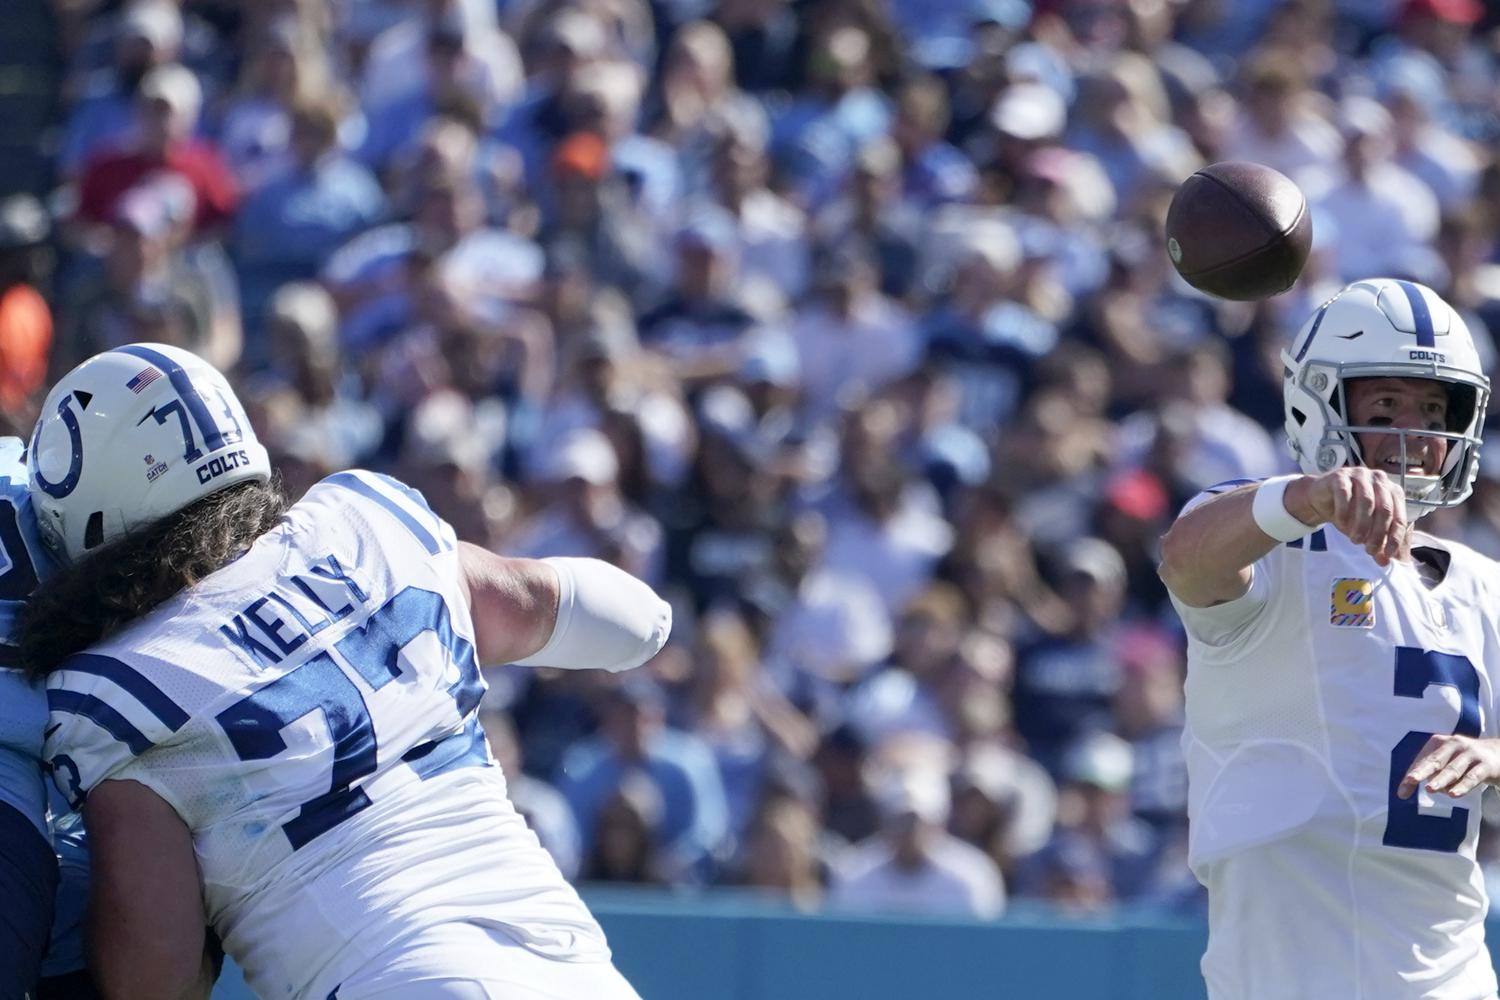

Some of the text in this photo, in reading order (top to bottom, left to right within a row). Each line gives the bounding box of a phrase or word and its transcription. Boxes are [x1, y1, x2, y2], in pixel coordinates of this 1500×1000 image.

[1409, 350, 1446, 363] COLTS
[147, 461, 169, 481] CATCH
[196, 450, 250, 485] COLTS
[218, 553, 371, 673] KELLY
[214, 585, 495, 852] 73
[1382, 645, 1486, 853] 2
